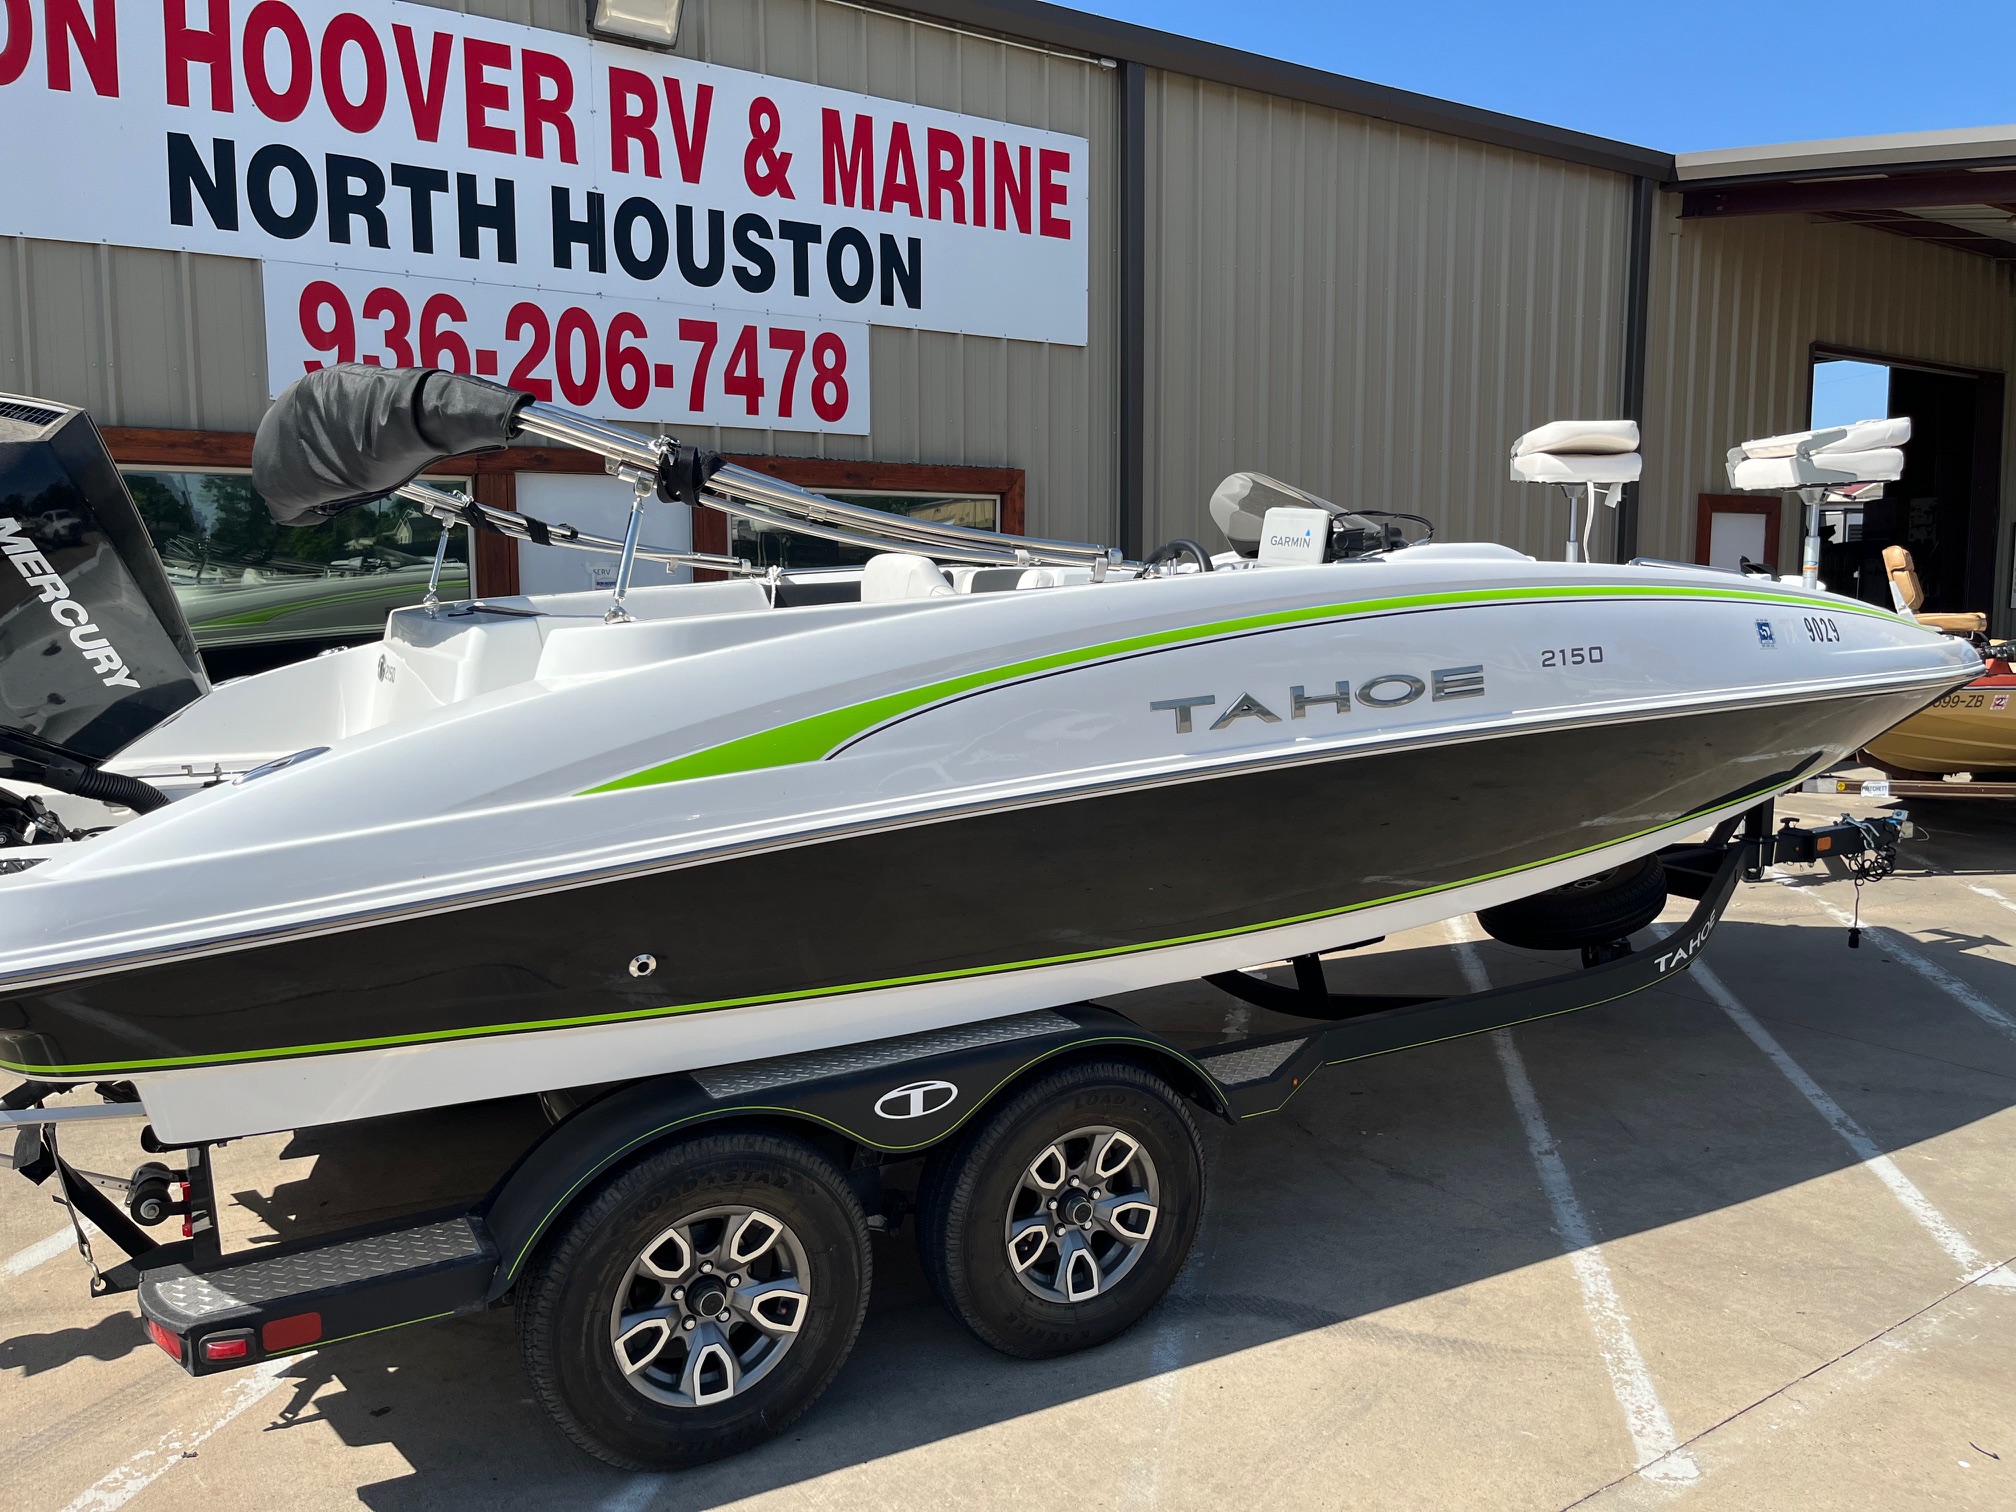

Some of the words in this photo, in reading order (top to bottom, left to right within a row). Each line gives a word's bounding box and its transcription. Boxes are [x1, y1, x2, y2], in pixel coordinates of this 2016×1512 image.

[164, 0, 578, 164] HOOVER
[609, 66, 714, 184] RV
[744, 97, 794, 199] &
[822, 107, 1071, 240] MARINE
[166, 131, 517, 264] NORTH
[551, 185, 922, 310] HOUSTON
[300, 281, 849, 422] 936-206-7478
[1270, 535, 1311, 548] GARMIN
[0, 517, 141, 688] MERCURY
[1803, 616, 1840, 642] 9029
[1541, 646, 1604, 667] 2150
[1150, 664, 1485, 734] TAHOE
[1654, 908, 1716, 973] TAHOE
[723, 1168, 789, 1189] STAR
